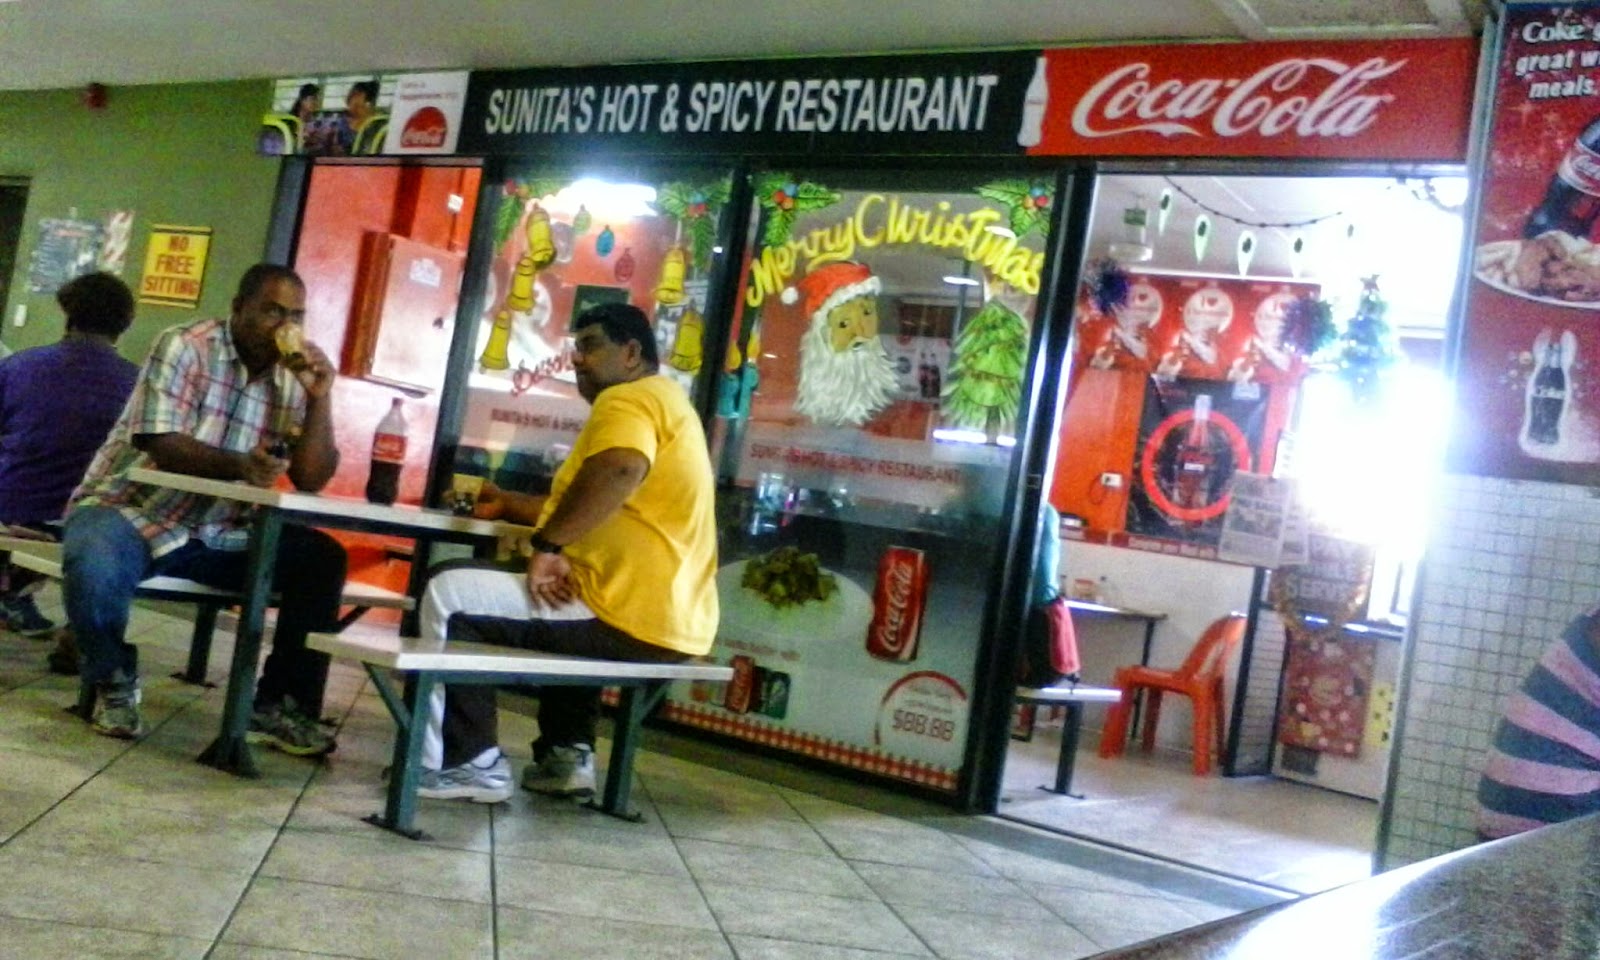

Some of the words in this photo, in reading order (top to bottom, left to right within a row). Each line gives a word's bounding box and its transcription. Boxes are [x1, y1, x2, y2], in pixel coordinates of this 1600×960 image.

[1522, 21, 1585, 43] Coke
[1515, 49, 1575, 77] great
[485, 84, 596, 135] SUNITA'S
[598, 82, 658, 131] HOT
[660, 83, 679, 132] &
[685, 79, 779, 132] SPICY
[775, 74, 998, 131] RESTAURANT
[1071, 56, 1409, 137] Coca-Cola
[169, 235, 190, 251] NO
[746, 216, 855, 308] Merry
[854, 193, 1046, 296] Christmas
[155, 254, 195, 275] FREE
[144, 275, 200, 297] SITTING
